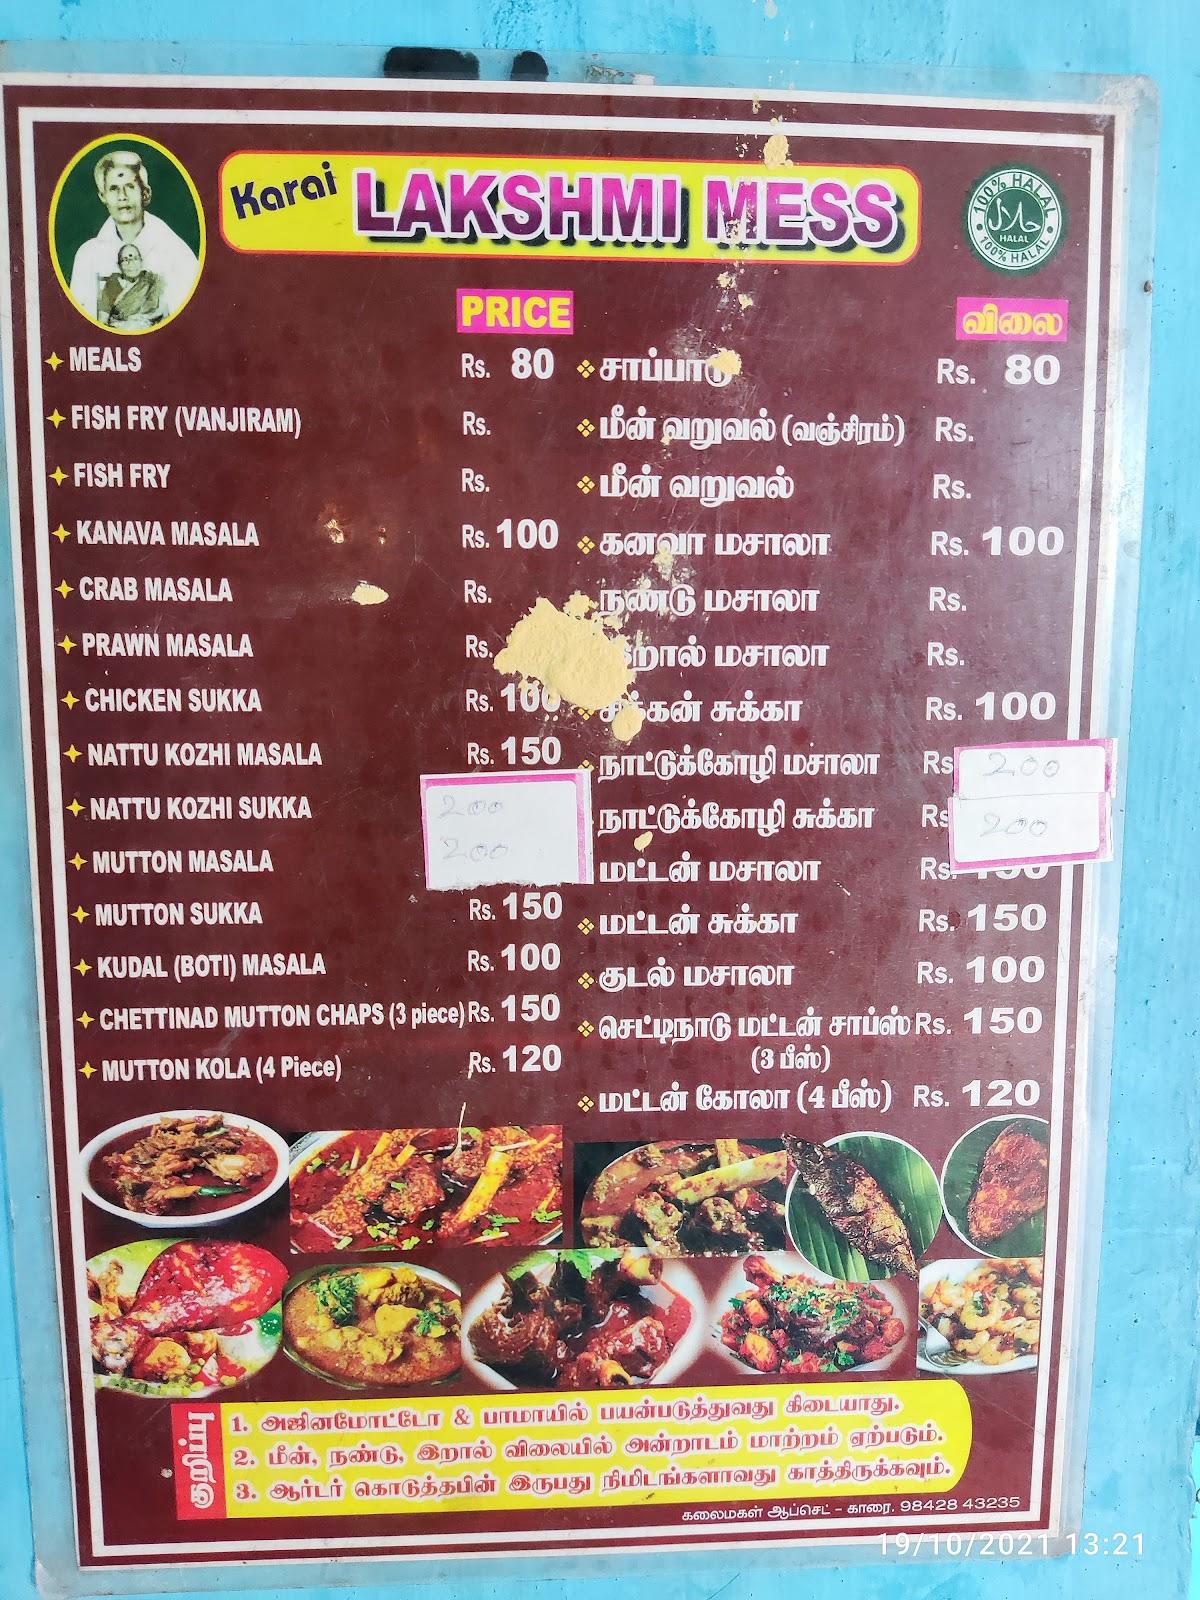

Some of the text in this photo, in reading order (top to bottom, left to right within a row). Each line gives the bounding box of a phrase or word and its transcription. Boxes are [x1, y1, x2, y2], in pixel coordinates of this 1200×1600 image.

[230, 161, 908, 251] Karai LAKSHMI MESS
[974, 174, 1056, 218] 100% HALAL
[1000, 235, 1028, 243] HALAL
[1011, 239, 1050, 263] HALAL
[461, 296, 572, 329] PRICE
[961, 305, 1064, 338] விலை
[69, 346, 555, 380] MEALS Rs. 80
[936, 358, 976, 385] Rs.
[1004, 353, 1061, 386] 80
[71, 404, 491, 440] FISH FRY (VANJIRAM) Rs.
[599, 403, 974, 451] மீன் வறுவல் (வஞ்சிரம்) Rs.
[73, 462, 490, 493] FISH FRY Rs.
[599, 462, 972, 508] மீன் வறுவல் Rs.
[76, 518, 559, 550] KANAVA MASALA Rs. 100
[599, 525, 1065, 559] கனவா மசாலா Rs. 100
[79, 576, 492, 604] CRAB MASALA Rs.
[600, 584, 967, 616] நண்டு மசாலா Rs.
[82, 632, 494, 659] PRAWN MASALA Rs.
[714, 644, 831, 668] மசாலா
[927, 641, 965, 667] Rs.
[84, 683, 561, 713] CHICKEN SUKKA Rs. 100
[600, 689, 1057, 723] ச்கன் சுக்கா Rs. 100
[87, 736, 562, 767] NATTU KOZHI MASALA Rs. 150
[597, 743, 955, 784] நாட்டுக்கோழி மசாலா Rs
[983, 752, 1060, 777] 200
[90, 795, 313, 821] NATTU KOZHI SUKKA
[437, 794, 503, 820] 200
[597, 797, 949, 841] நாட்டுக்கோழி சுக்கா Rs
[979, 813, 1048, 838] 200
[92, 849, 274, 874] MUTTON MASALA
[440, 837, 508, 862] 200
[599, 850, 702, 883] மட்டன்
[708, 860, 822, 882] மசாலா
[94, 891, 563, 927] MUTTON SUKKA Rs. 150
[599, 902, 1047, 935] மட்டன் சுக்கா Rs. 150
[97, 942, 561, 984] KUDAL (BOTI) MASALA Rs. 100
[598, 955, 1045, 992] குடல் மசாலா Rs. 100
[99, 993, 561, 1031] CHETTINAD MUTTON CHAPS (3 piece) Rs. 150
[598, 1004, 1043, 1046] செட்டிநாடு மட்டன் சாப்ஸ் Rs. 150
[101, 1044, 562, 1085] MUTTON KOLA (4 Piece) Rs. 120
[751, 1043, 831, 1075] (3 பீஸ்)
[598, 1077, 1041, 1115] மட்டன் கோலா (4 பீஸ்) Rs. 120
[230, 1392, 901, 1434] 1. அஜினமோட்டோ & பாமாயில் பயன்படுத்துவது கிடையாது.
[233, 1423, 944, 1467] 2. மீன், நண்டு, இறால் விலையில் அன்றாடம் மாற்றம் ஏற்படும்.
[234, 1457, 952, 1502] 3. ஆர்டர் கொடுத்தபின் இருபது நிமிடங்களாவது காத்திருக்கவும்.
[682, 1506, 762, 1522] கலைமகள்
[767, 1503, 830, 1519] ஆப்செட்
[847, 1503, 895, 1515] காரை.
[900, 1499, 958, 1513] 98428
[962, 1497, 1020, 1510] 43235
